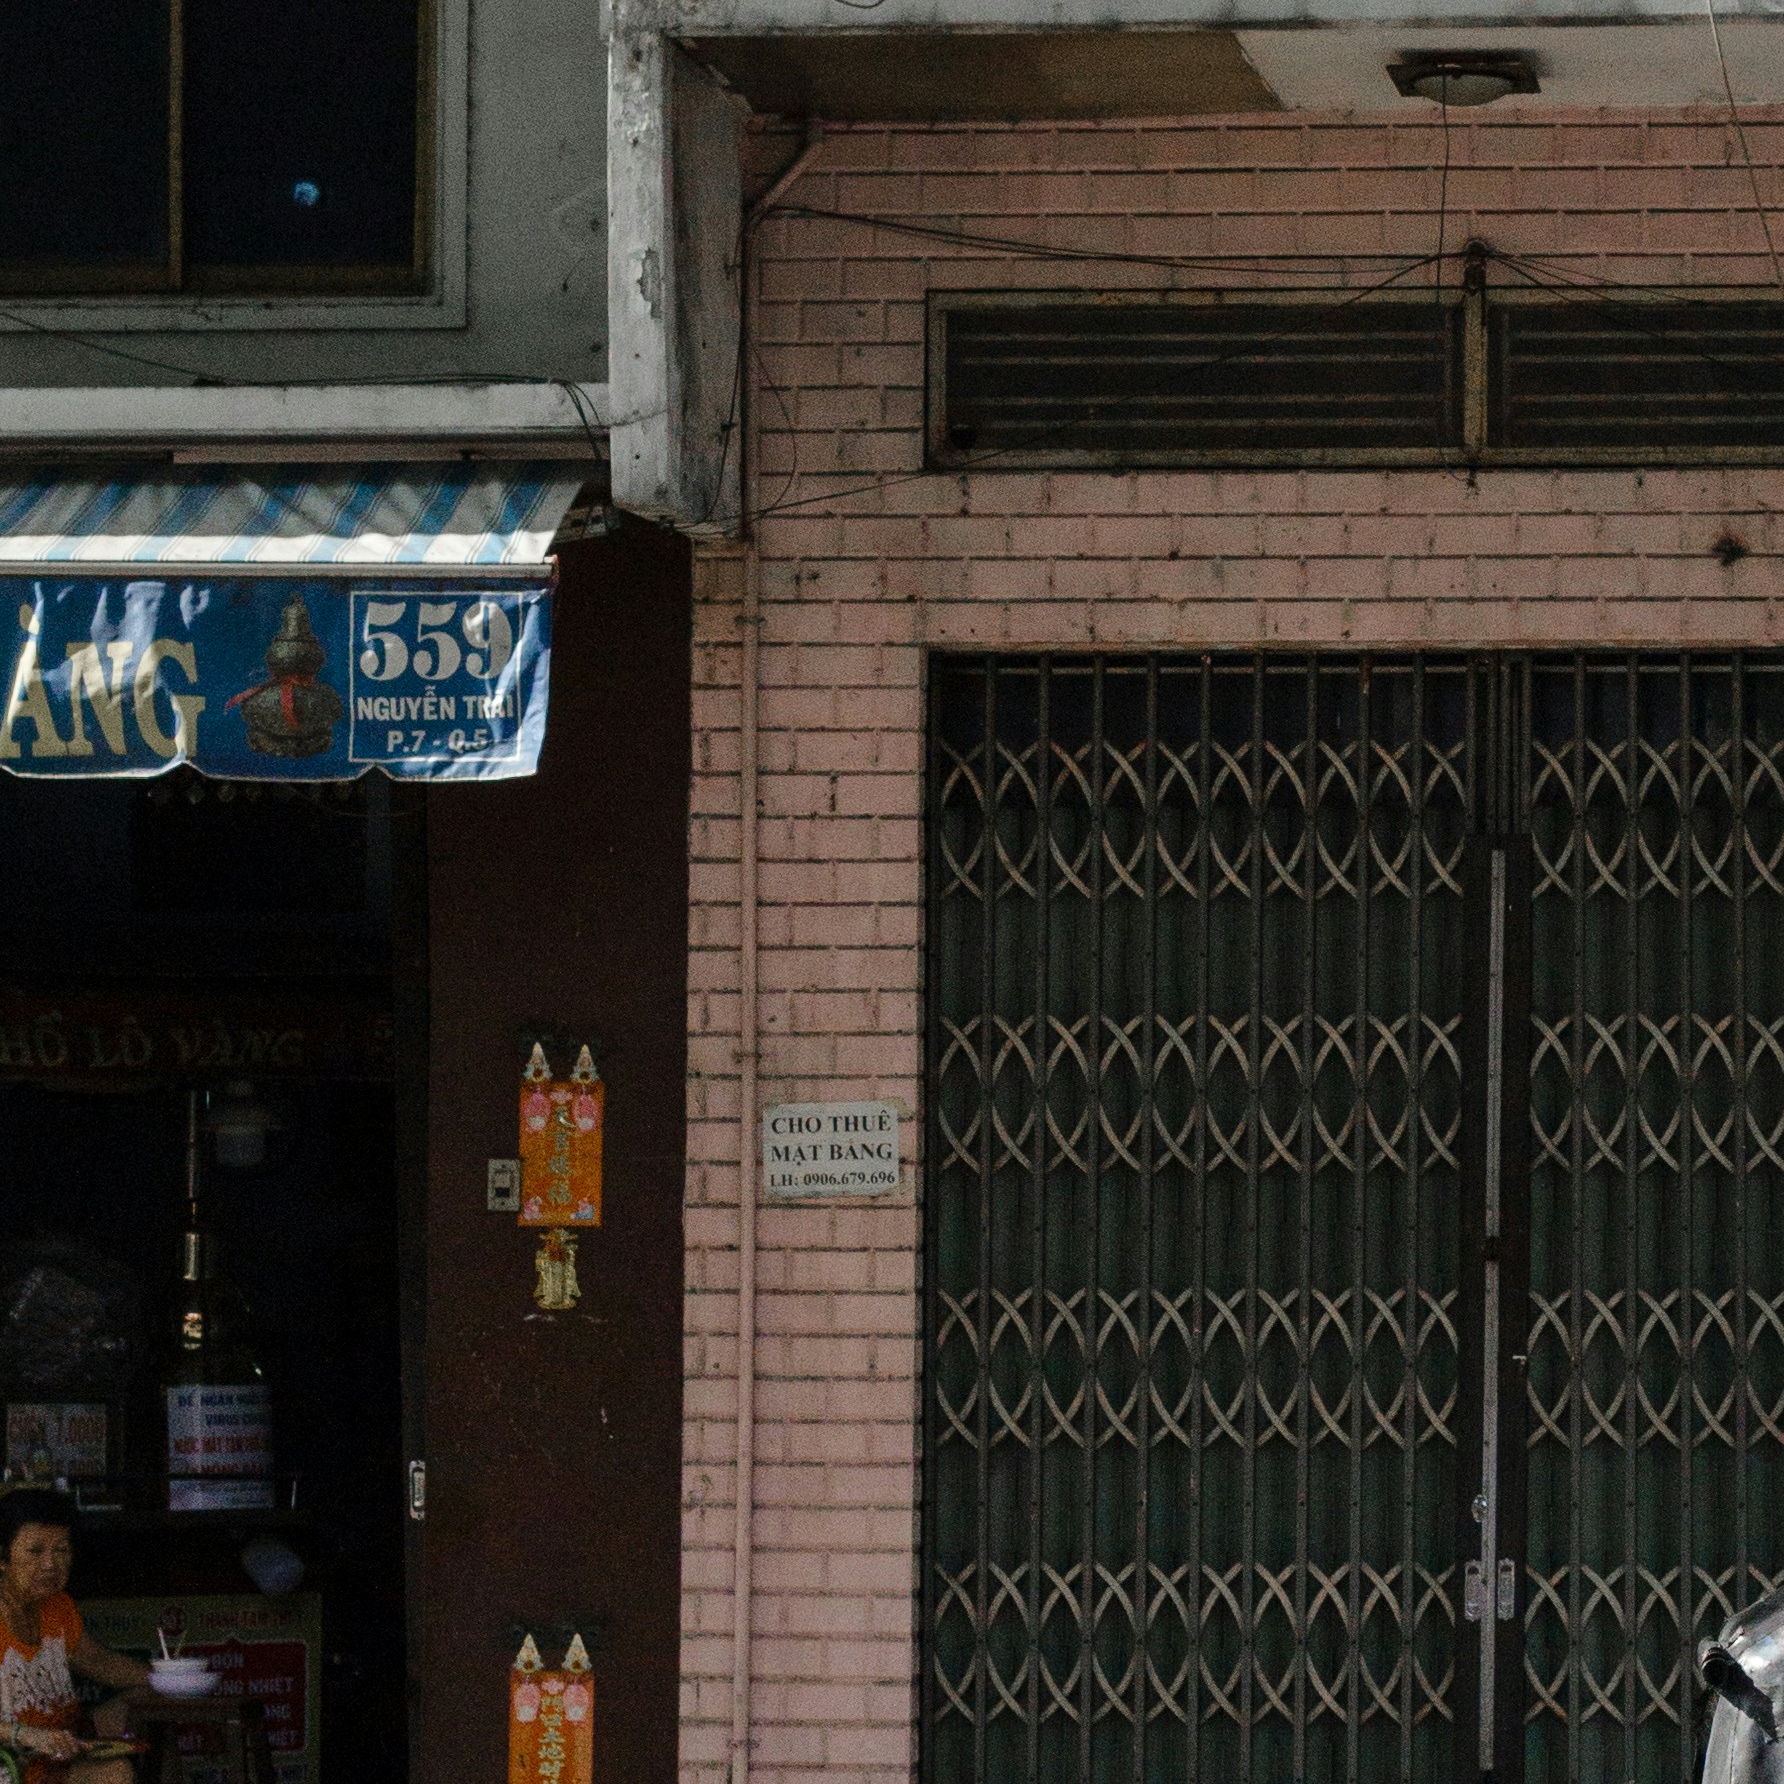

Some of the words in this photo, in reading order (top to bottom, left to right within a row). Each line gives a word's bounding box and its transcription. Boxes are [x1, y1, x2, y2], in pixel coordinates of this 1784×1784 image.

[360, 601, 512, 680] 559
[357, 685, 456, 721] NGUYỄN
[387, 729, 426, 753] P.7
[447, 728, 487, 754] Q.5
[771, 1116, 822, 1134] CHO
[828, 1110, 892, 1133] THUÊ
[770, 1174, 799, 1187] LH:
[803, 1171, 896, 1186] 0906.679.696
